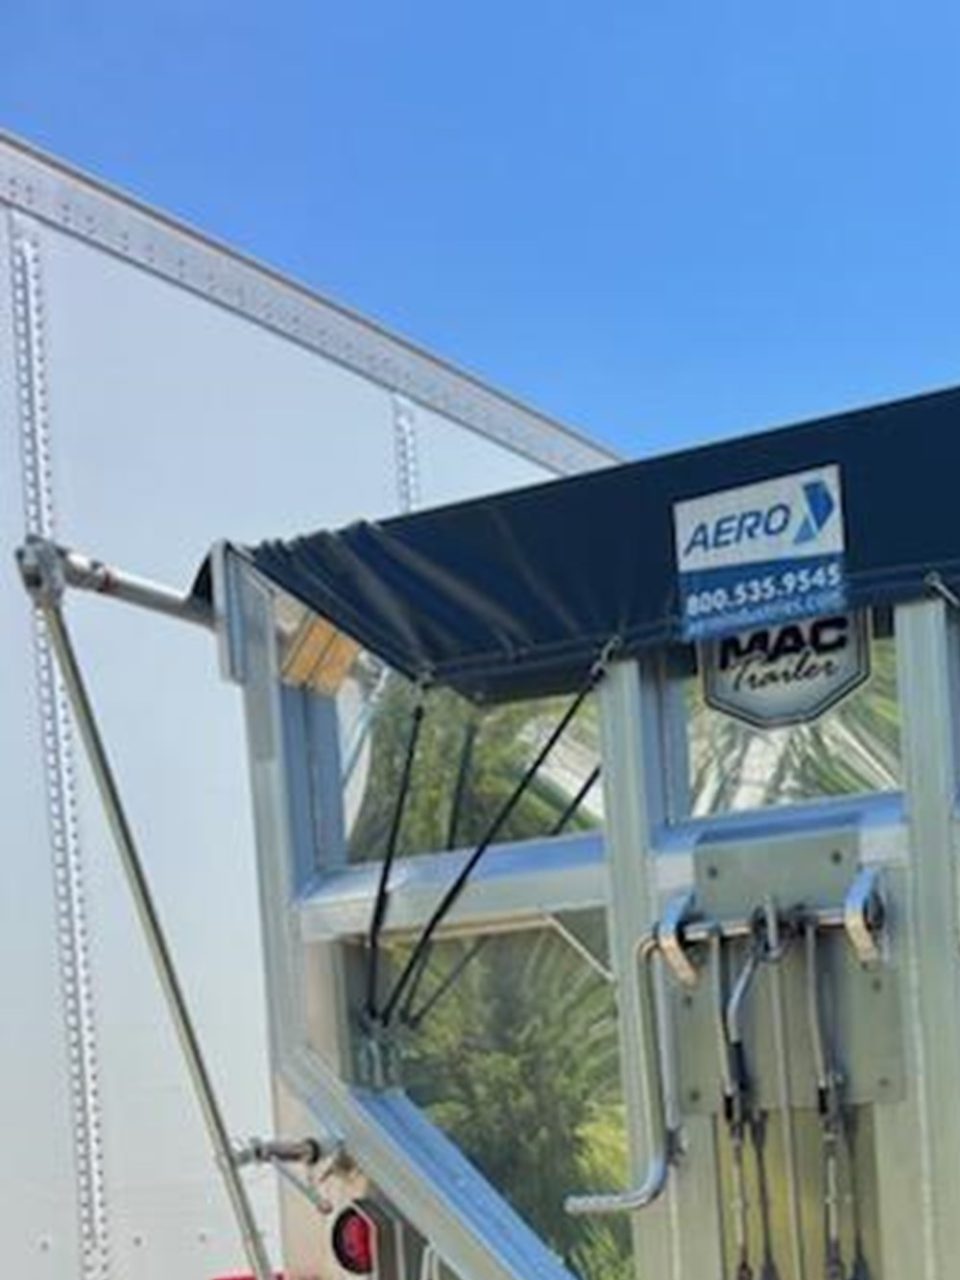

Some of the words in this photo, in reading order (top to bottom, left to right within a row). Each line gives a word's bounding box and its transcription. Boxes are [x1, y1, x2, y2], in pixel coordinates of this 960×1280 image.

[684, 503, 790, 556] AERO
[686, 563, 842, 616] 800.535.9545
[719, 616, 848, 670] MAC
[732, 650, 834, 692] Trailer
